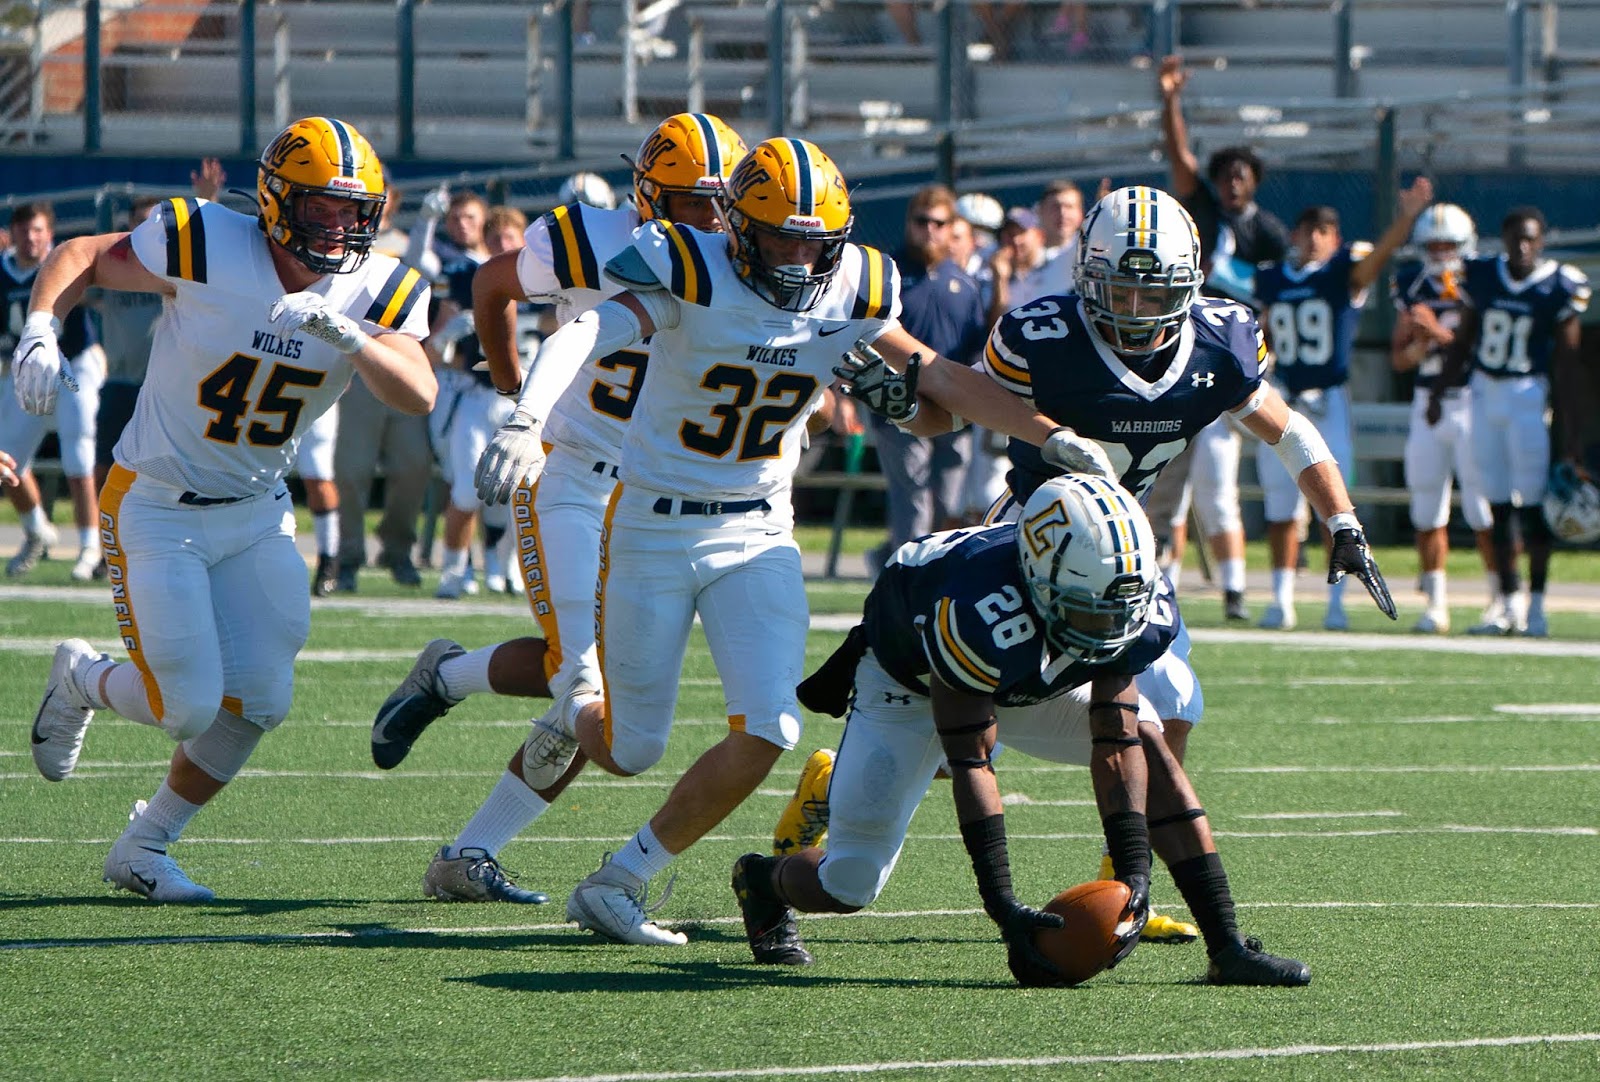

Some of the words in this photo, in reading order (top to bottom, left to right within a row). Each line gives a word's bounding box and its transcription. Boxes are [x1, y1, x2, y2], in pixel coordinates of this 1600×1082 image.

[789, 218, 821, 228] Riddell
[251, 330, 303, 359] WILKES
[1011, 301, 1069, 341] 33
[1268, 299, 1334, 366] 89
[1477, 309, 1535, 374] 81
[745, 345, 798, 367] WILKES
[197, 351, 328, 447] 45
[678, 362, 820, 463] 32
[1111, 419, 1182, 434] WARRIORS
[101, 511, 138, 651] COLONELS
[516, 488, 550, 616] COLONELS
[974, 585, 1036, 650] 28
